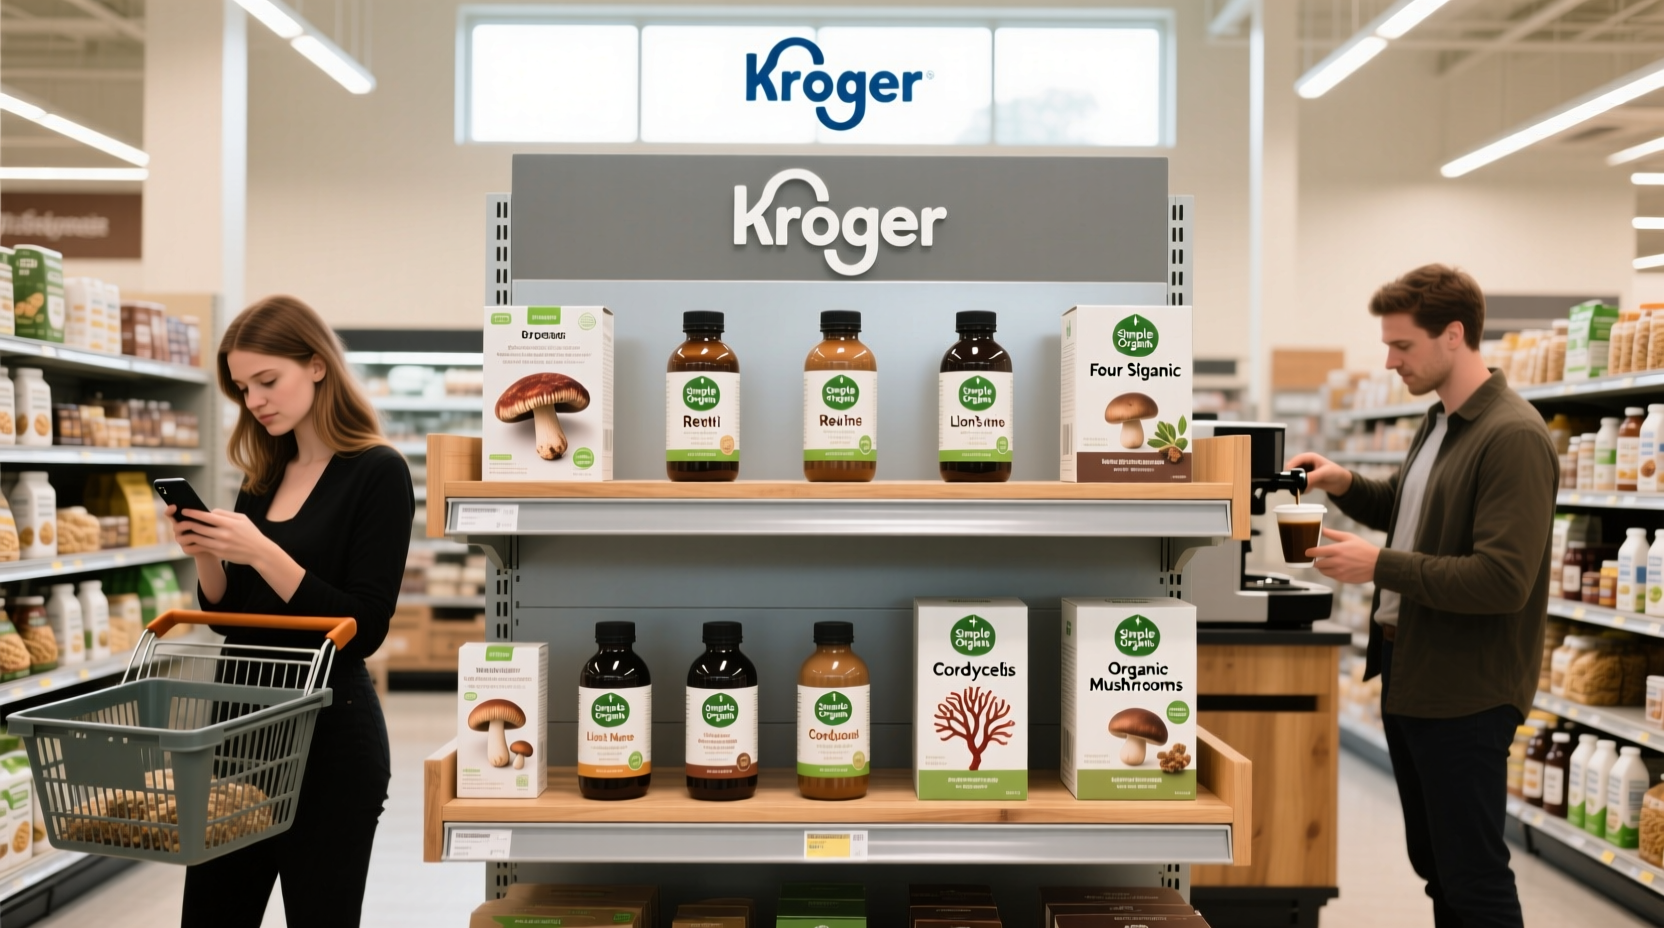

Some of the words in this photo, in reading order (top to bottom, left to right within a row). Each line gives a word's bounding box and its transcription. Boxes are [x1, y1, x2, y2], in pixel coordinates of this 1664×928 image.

[746, 37, 923, 131] Kroger
[734, 168, 948, 276] Kroger
[1090, 363, 1123, 377] Four
[1108, 661, 1169, 679] Organic
